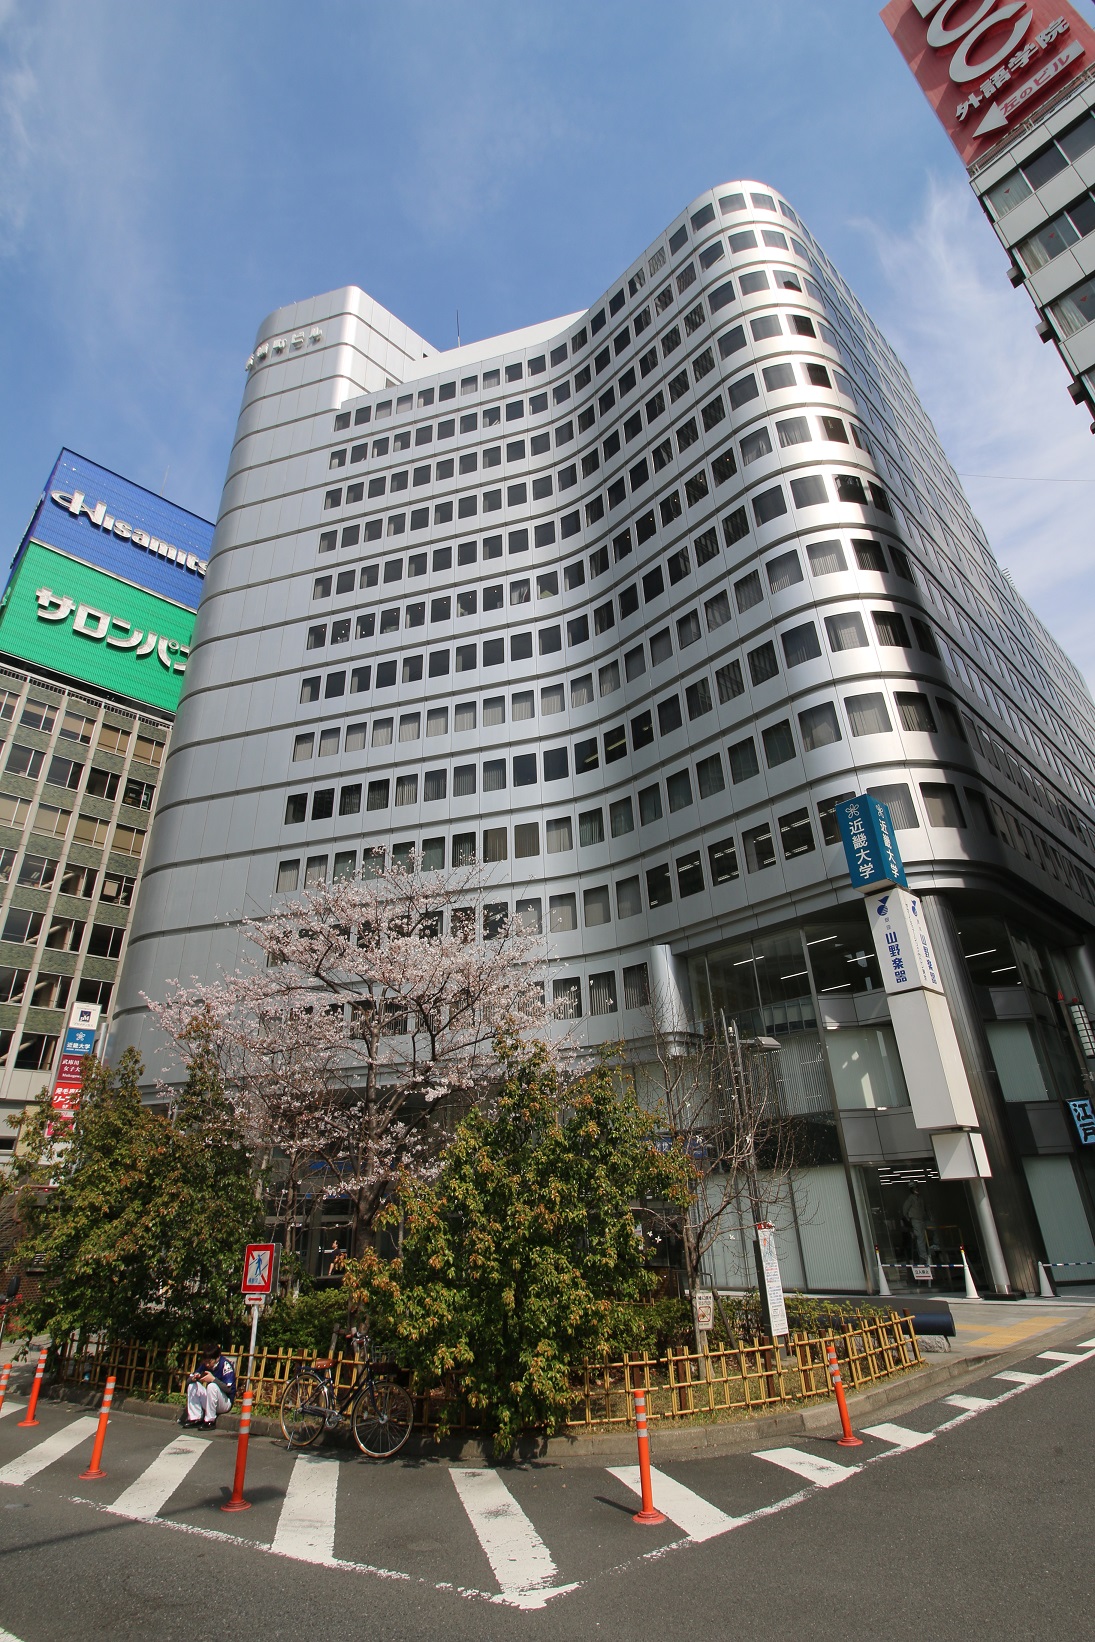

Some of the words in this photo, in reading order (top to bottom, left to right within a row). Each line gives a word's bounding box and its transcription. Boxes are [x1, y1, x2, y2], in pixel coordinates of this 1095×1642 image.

[955, 15, 1070, 121] 外語学院
[1000, 53, 1070, 115] 左のビル
[849, 818, 875, 880] 近畿大学
[879, 819, 899, 878] 近畿大学
[885, 931, 907, 983] 山野楽器
